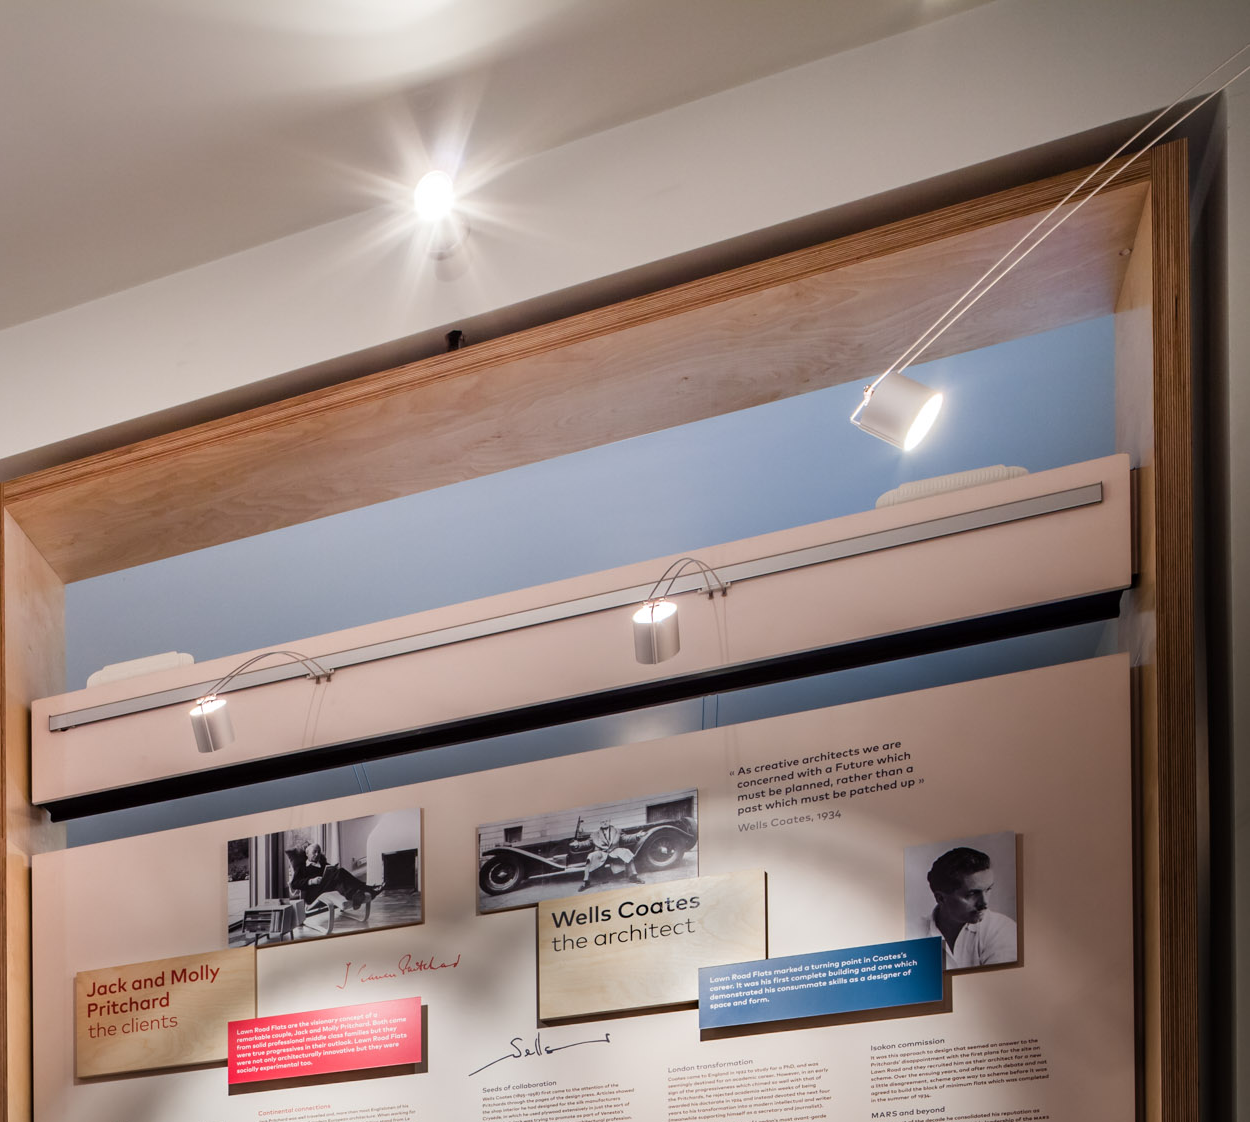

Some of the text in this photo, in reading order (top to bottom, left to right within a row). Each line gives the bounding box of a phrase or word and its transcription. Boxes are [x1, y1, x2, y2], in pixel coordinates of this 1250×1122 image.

[738, 742, 901, 775] As creative architects we are
[738, 751, 910, 788] concerned with a Future which
[738, 766, 913, 801] must be planned, rather than a
[738, 779, 915, 816] past which must be patched up
[738, 809, 841, 832] Wells Coates, 1934
[551, 896, 700, 928] Wells Coates
[551, 918, 696, 952] the architect
[732, 972, 751, 980] Road
[753, 970, 772, 978] Flats
[774, 965, 802, 975] marked
[812, 962, 839, 970] turning
[842, 958, 861, 968] point
[873, 952, 906, 962] Coates's
[774, 976, 789, 984] first
[791, 972, 826, 982] complete
[829, 968, 859, 977] building
[861, 965, 876, 973] and
[894, 960, 917, 969] which
[87, 964, 220, 997] Jack and Molly
[710, 988, 763, 1000] demonstrated
[765, 986, 775, 994] his
[777, 981, 826, 992] consummate
[829, 978, 847, 986] skills
[867, 973, 900, 981] designer
[903, 969, 911, 977] of
[87, 992, 169, 1018] Pritchard
[710, 1002, 730, 1010] space
[733, 998, 747, 1006] and
[88, 1015, 178, 1038] the clients
[237, 1033, 270, 1042] remarkable
[272, 1030, 293, 1038] couple,
[340, 1021, 371, 1030] Pritchard.
[373, 1018, 388, 1026] Both
[255, 1025, 270, 1033] Road
[311, 1018, 338, 1026] visionary
[340, 1014, 363, 1022] concept
[898, 1038, 945, 1048] commission
[668, 1059, 753, 1073] London transformation
[512, 1081, 556, 1090] collaboration
[258, 1104, 330, 1116] Continental connections
[916, 1106, 945, 1115] beyond
